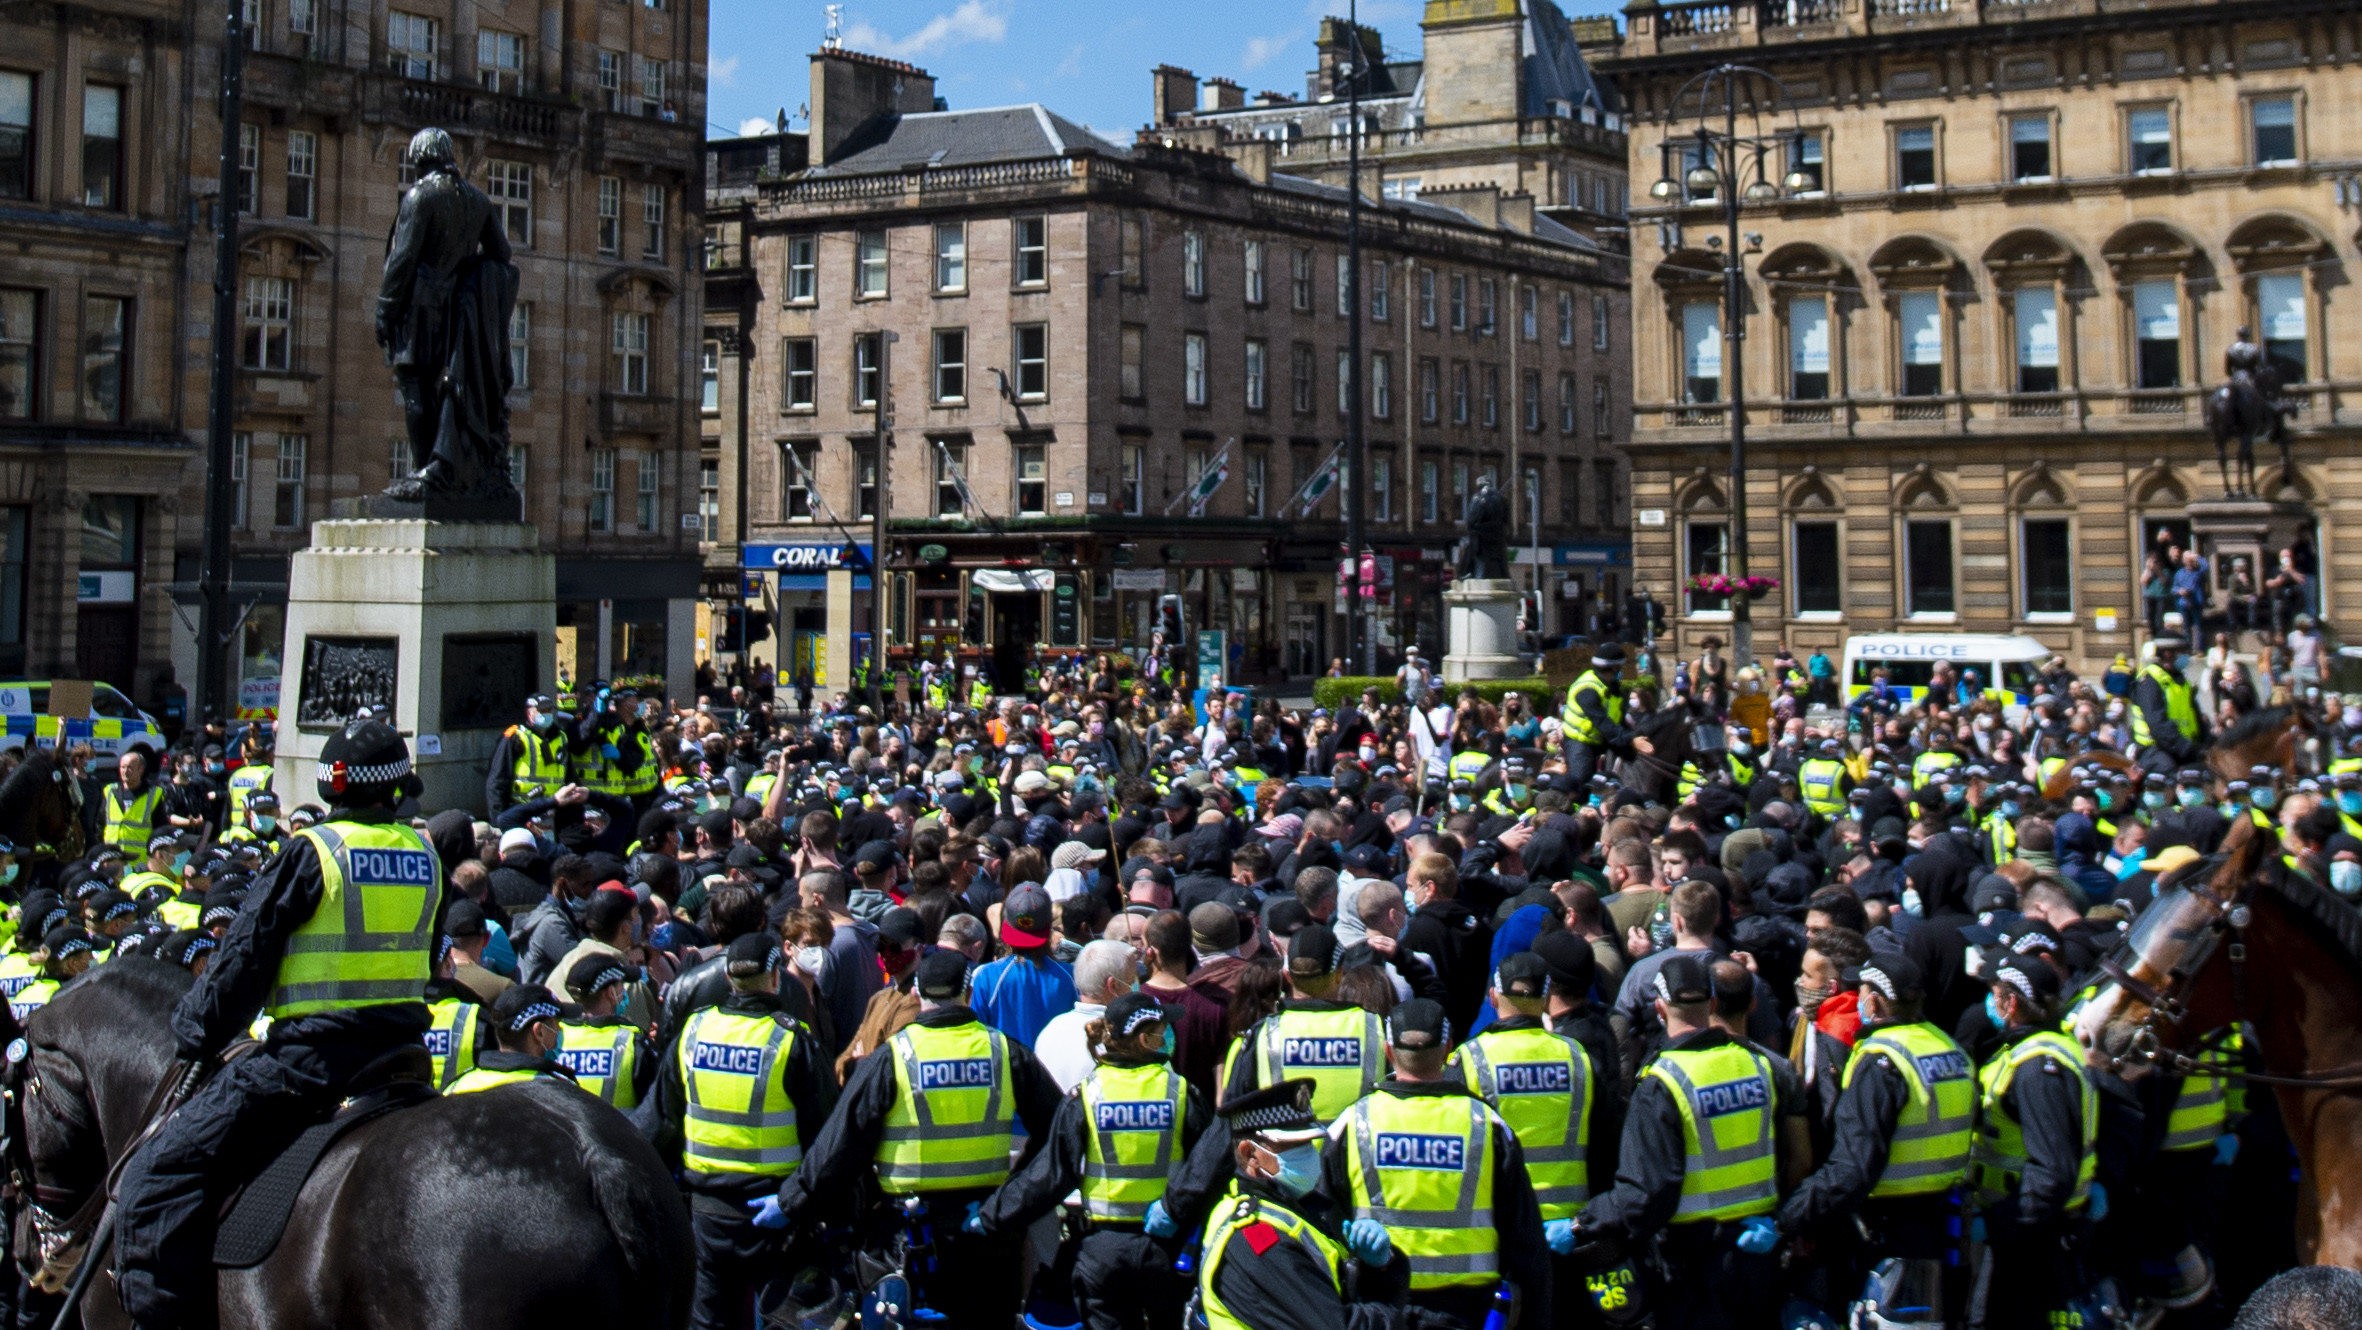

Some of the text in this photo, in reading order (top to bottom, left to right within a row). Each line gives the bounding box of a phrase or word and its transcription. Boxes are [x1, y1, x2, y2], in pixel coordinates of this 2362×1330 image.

[772, 547, 841, 566] CORAL
[1862, 644, 1968, 656] POLICE
[353, 852, 430, 880] POLICE
[554, 1052, 610, 1074] OLICE
[694, 1043, 760, 1072] POLICE
[1285, 1039, 1359, 1063] POLICE
[921, 1061, 990, 1087] POLICE
[1498, 1065, 1569, 1091] POLICE
[1700, 1080, 1765, 1115] POLICE
[1100, 1104, 1171, 1128] POLICE
[1379, 1136, 1462, 1165] POLICE
[1600, 1286, 1629, 1311] SP
